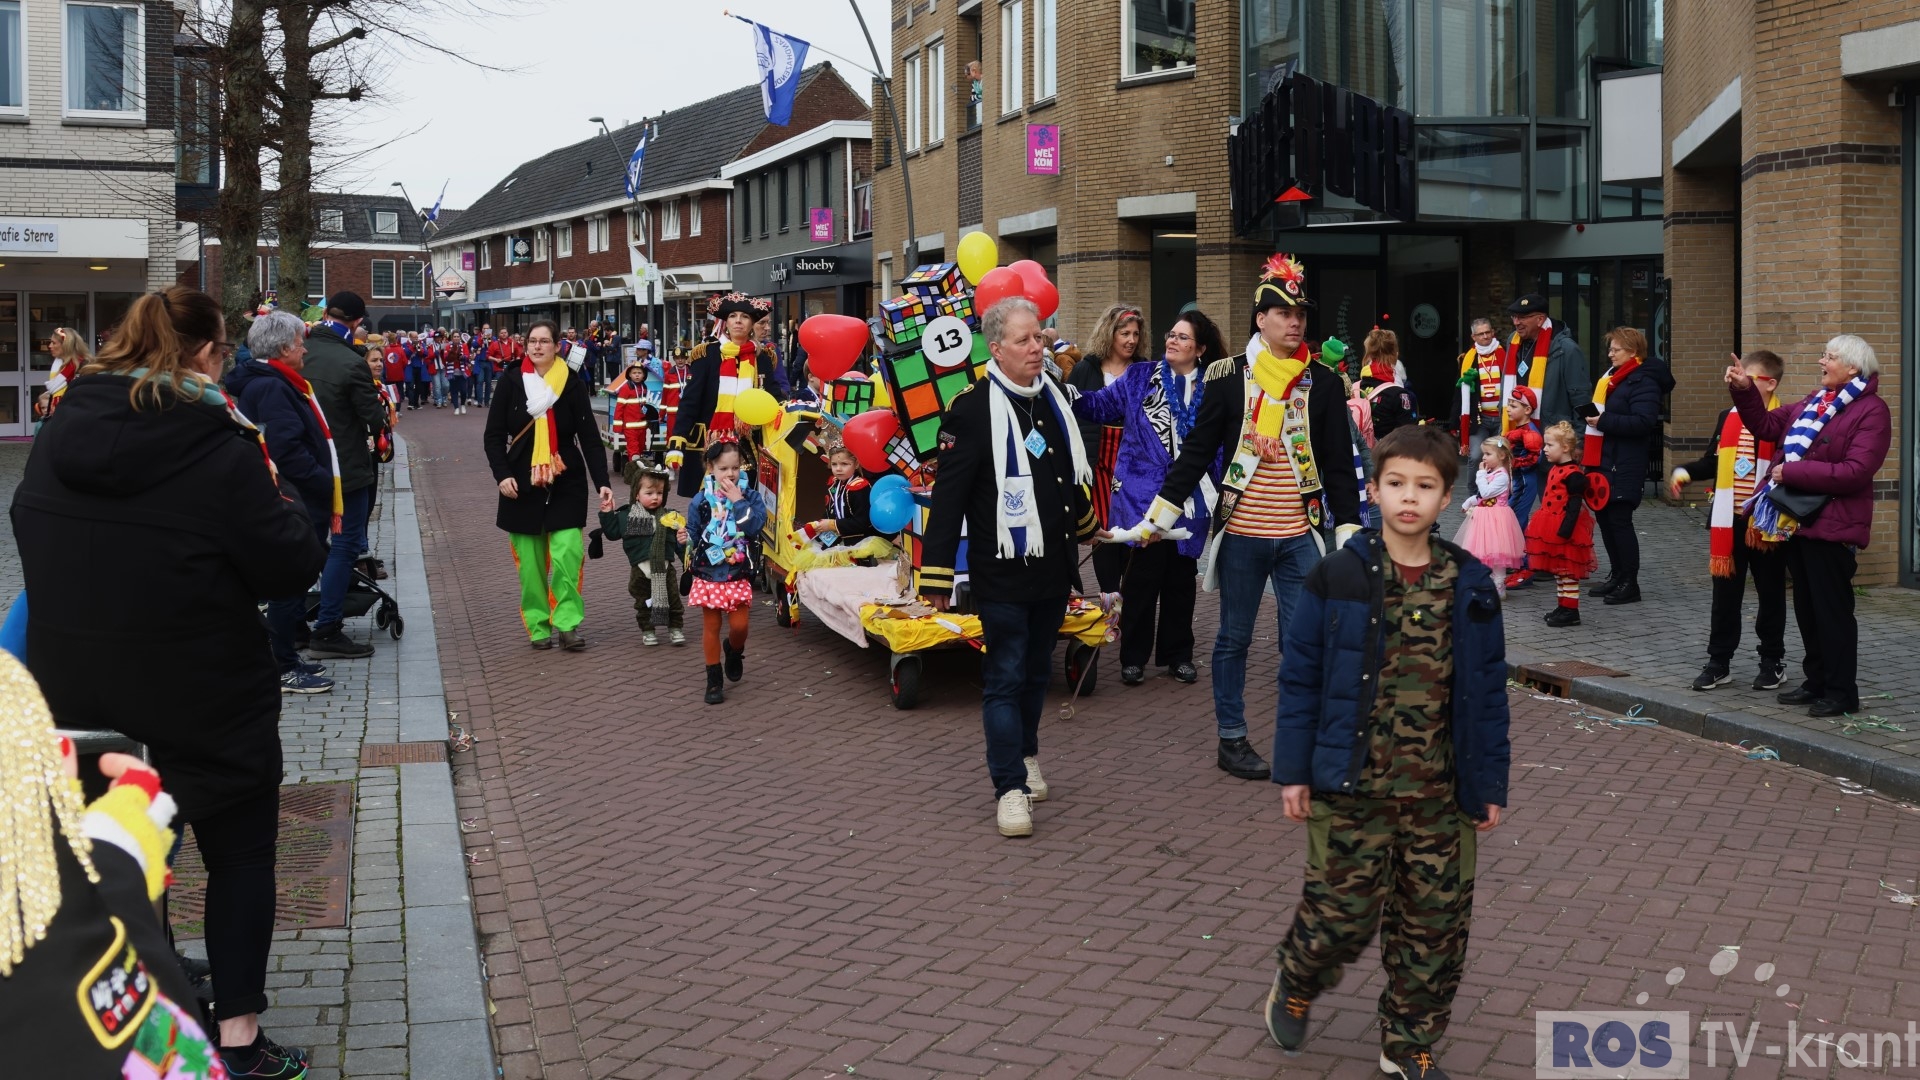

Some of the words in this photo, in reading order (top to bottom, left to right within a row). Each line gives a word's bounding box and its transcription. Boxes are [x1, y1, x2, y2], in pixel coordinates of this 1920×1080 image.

[1034, 148, 1053, 157] WEL
[1034, 157, 1053, 167] KOM
[24, 228, 54, 242] Sterre
[796, 259, 834, 273] shoeby
[934, 328, 963, 354] 13
